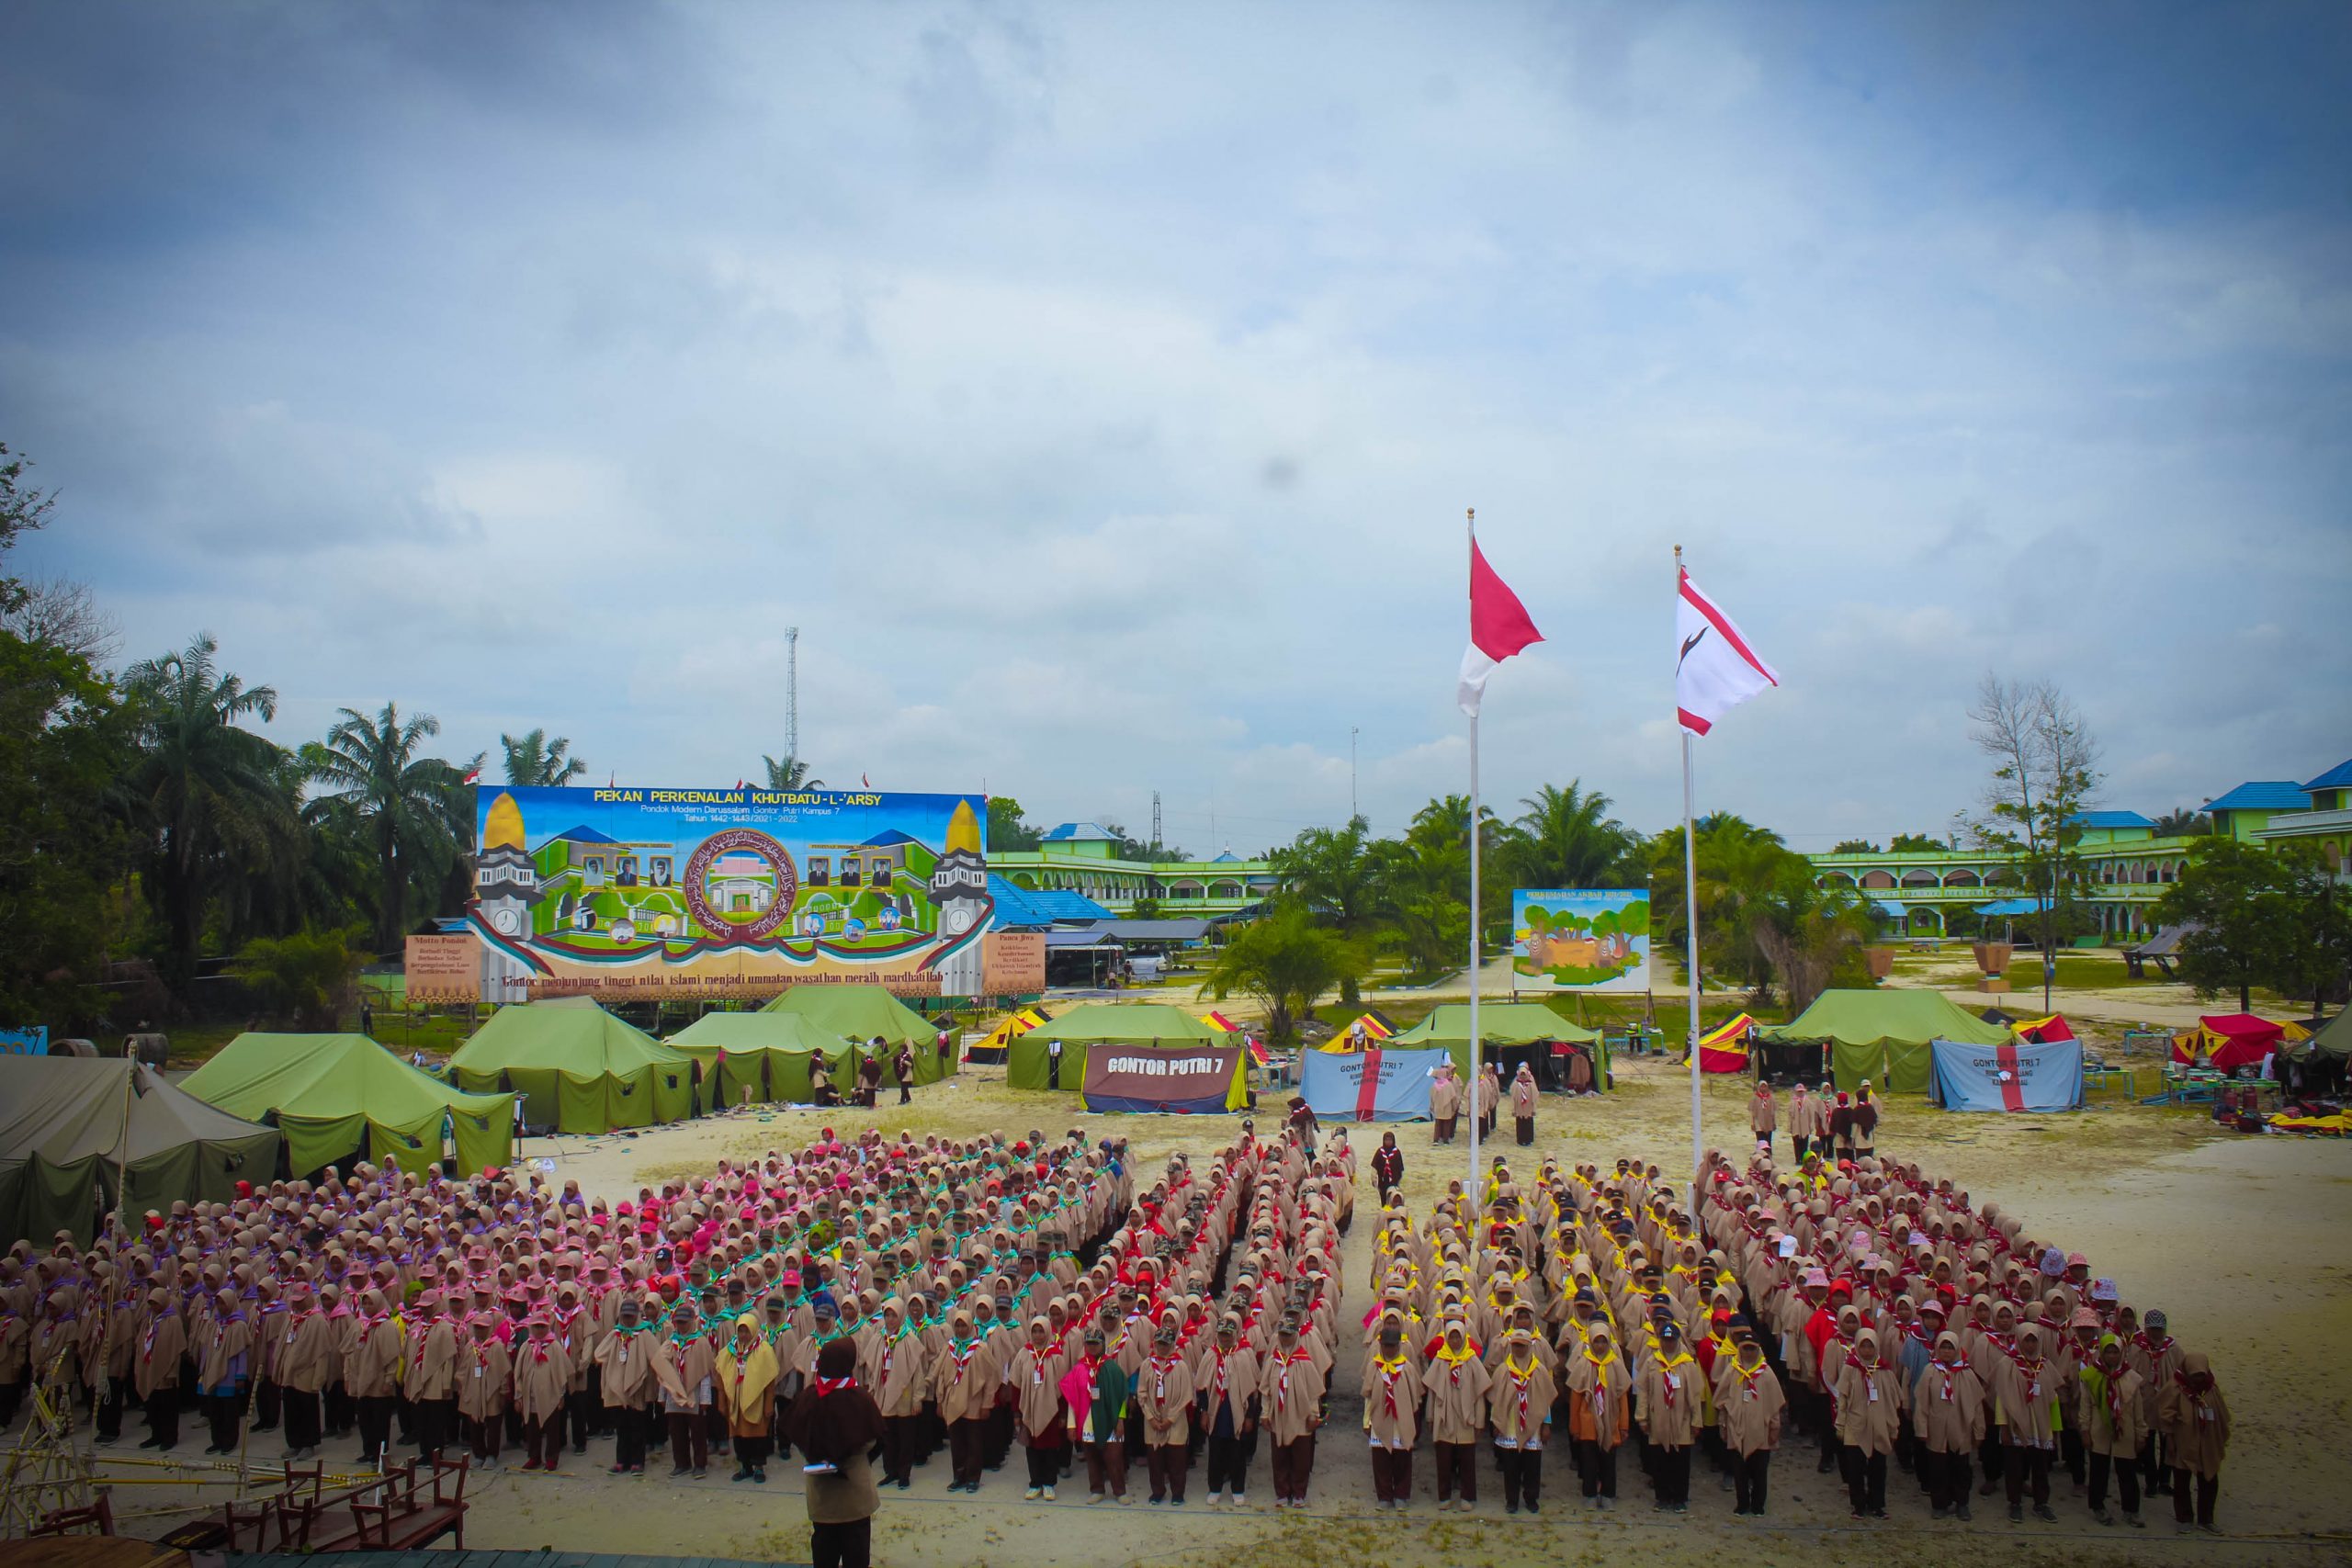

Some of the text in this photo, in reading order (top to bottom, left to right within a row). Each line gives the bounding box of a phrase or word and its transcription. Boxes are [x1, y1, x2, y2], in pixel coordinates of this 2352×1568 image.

[594, 790, 642, 802] PEKAN
[650, 791, 743, 803] PERKENALAN
[640, 805, 669, 813] Pondok
[672, 806, 702, 814] Modern
[704, 806, 750, 814] Darussalam
[802, 807, 831, 816] Kampus
[542, 976, 600, 989] menjunjung
[605, 976, 636, 987] tinggi
[639, 974, 664, 986] nilai
[670, 974, 701, 985] islami
[705, 974, 745, 987] menjadi
[748, 974, 792, 984] ummatan
[795, 973, 842, 983] wasathan
[845, 972, 879, 983] meraih
[1107, 1057, 1224, 1076] GONTOR PUTRI 7
[1340, 1060, 1404, 1073] GONTOR PUTRI 7
[1973, 1058, 2007, 1067] GONTOR
[2010, 1058, 2034, 1066] PUTRI
